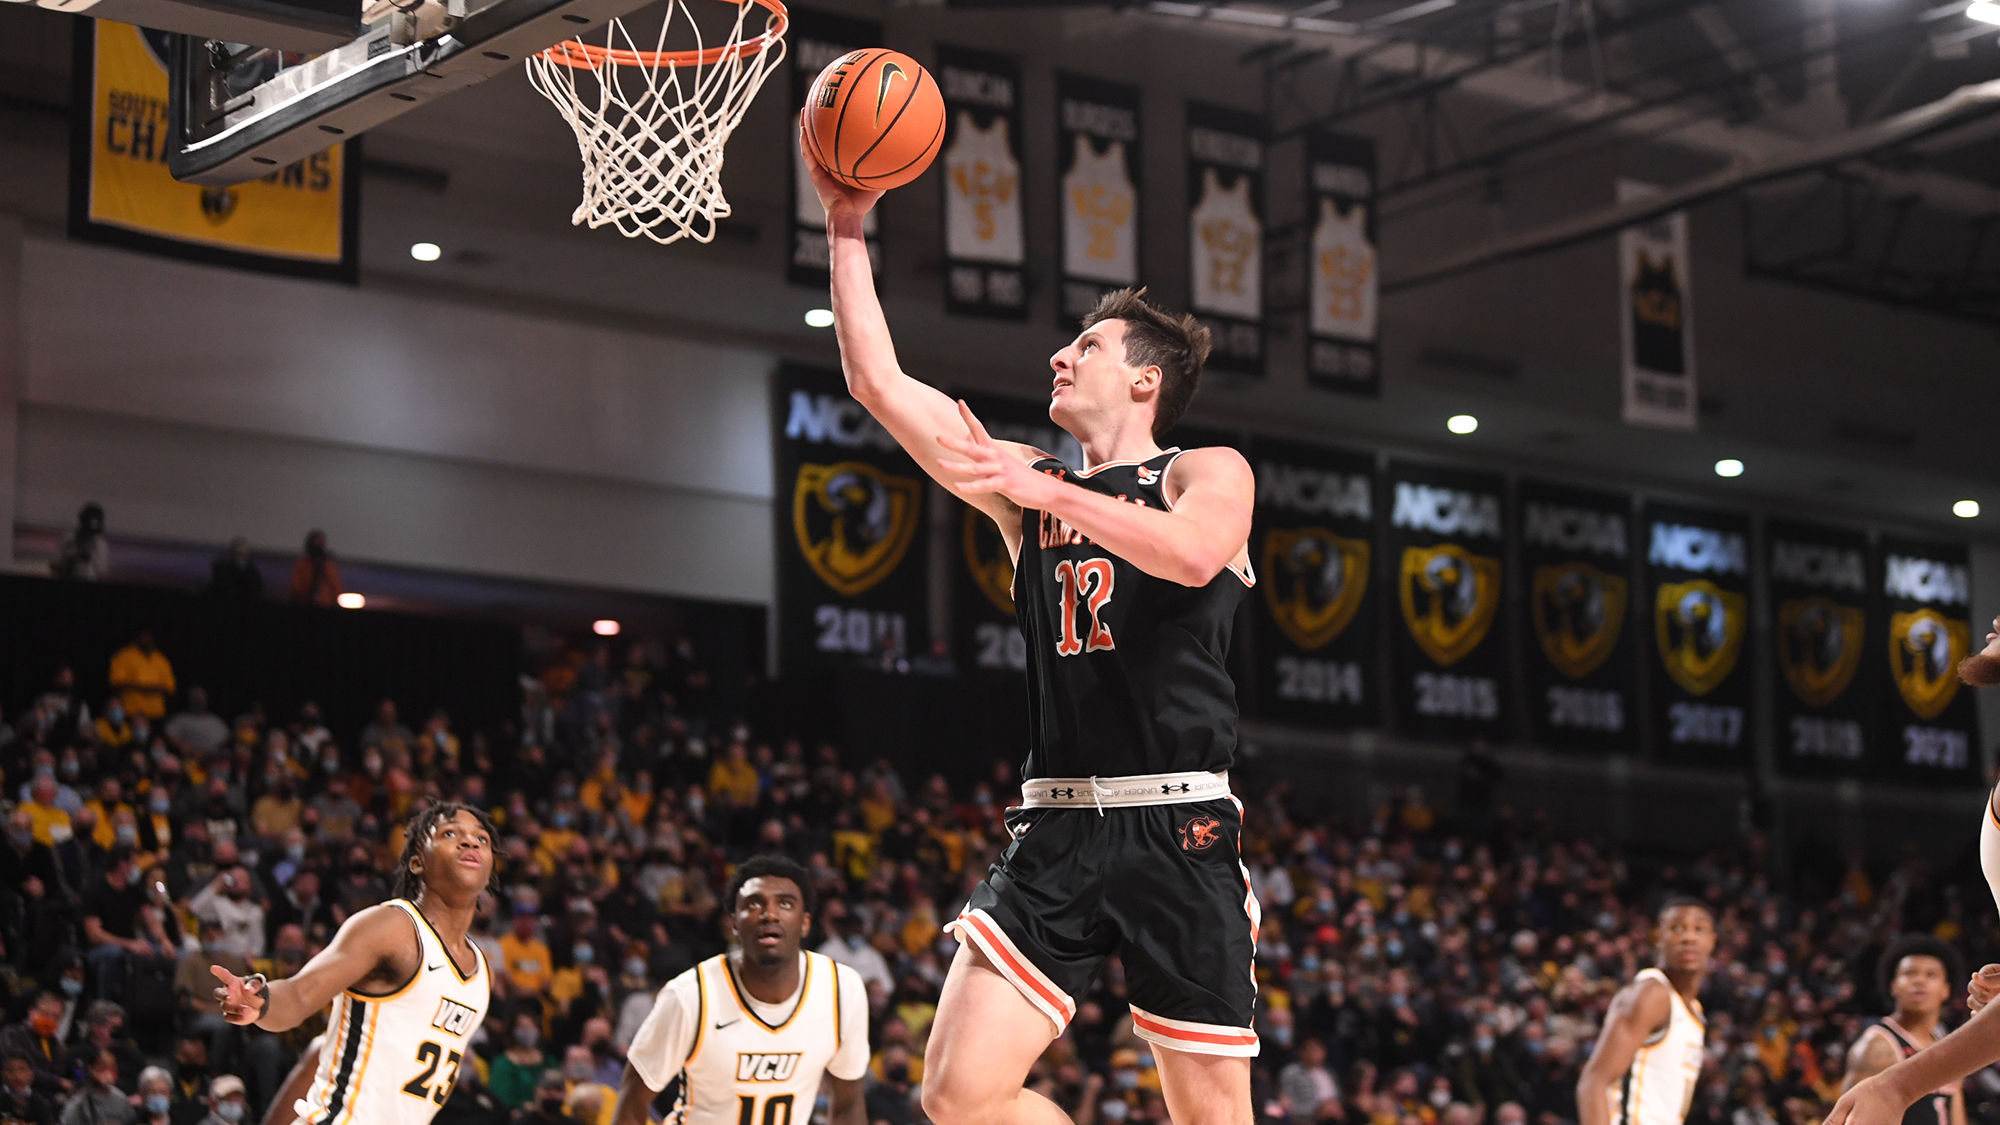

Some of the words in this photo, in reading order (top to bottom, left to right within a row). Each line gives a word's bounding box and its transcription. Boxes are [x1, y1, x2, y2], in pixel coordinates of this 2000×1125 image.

[817, 51, 869, 108] ELITE
[786, 391, 899, 452] NC
[1254, 463, 1372, 521] NCAA
[1393, 482, 1499, 539] NCAA
[1524, 504, 1626, 558] NCAA
[1649, 522, 1747, 576] NCAA
[1772, 540, 1864, 592] NCAA
[1885, 555, 1968, 605] NCAA
[1055, 558, 1115, 657] 12
[1275, 656, 1361, 704] 2014
[1124, 787, 1158, 796] UNDER
[430, 995, 478, 1038] VCU
[401, 1039, 463, 1109] 23
[735, 1052, 803, 1084] VCU
